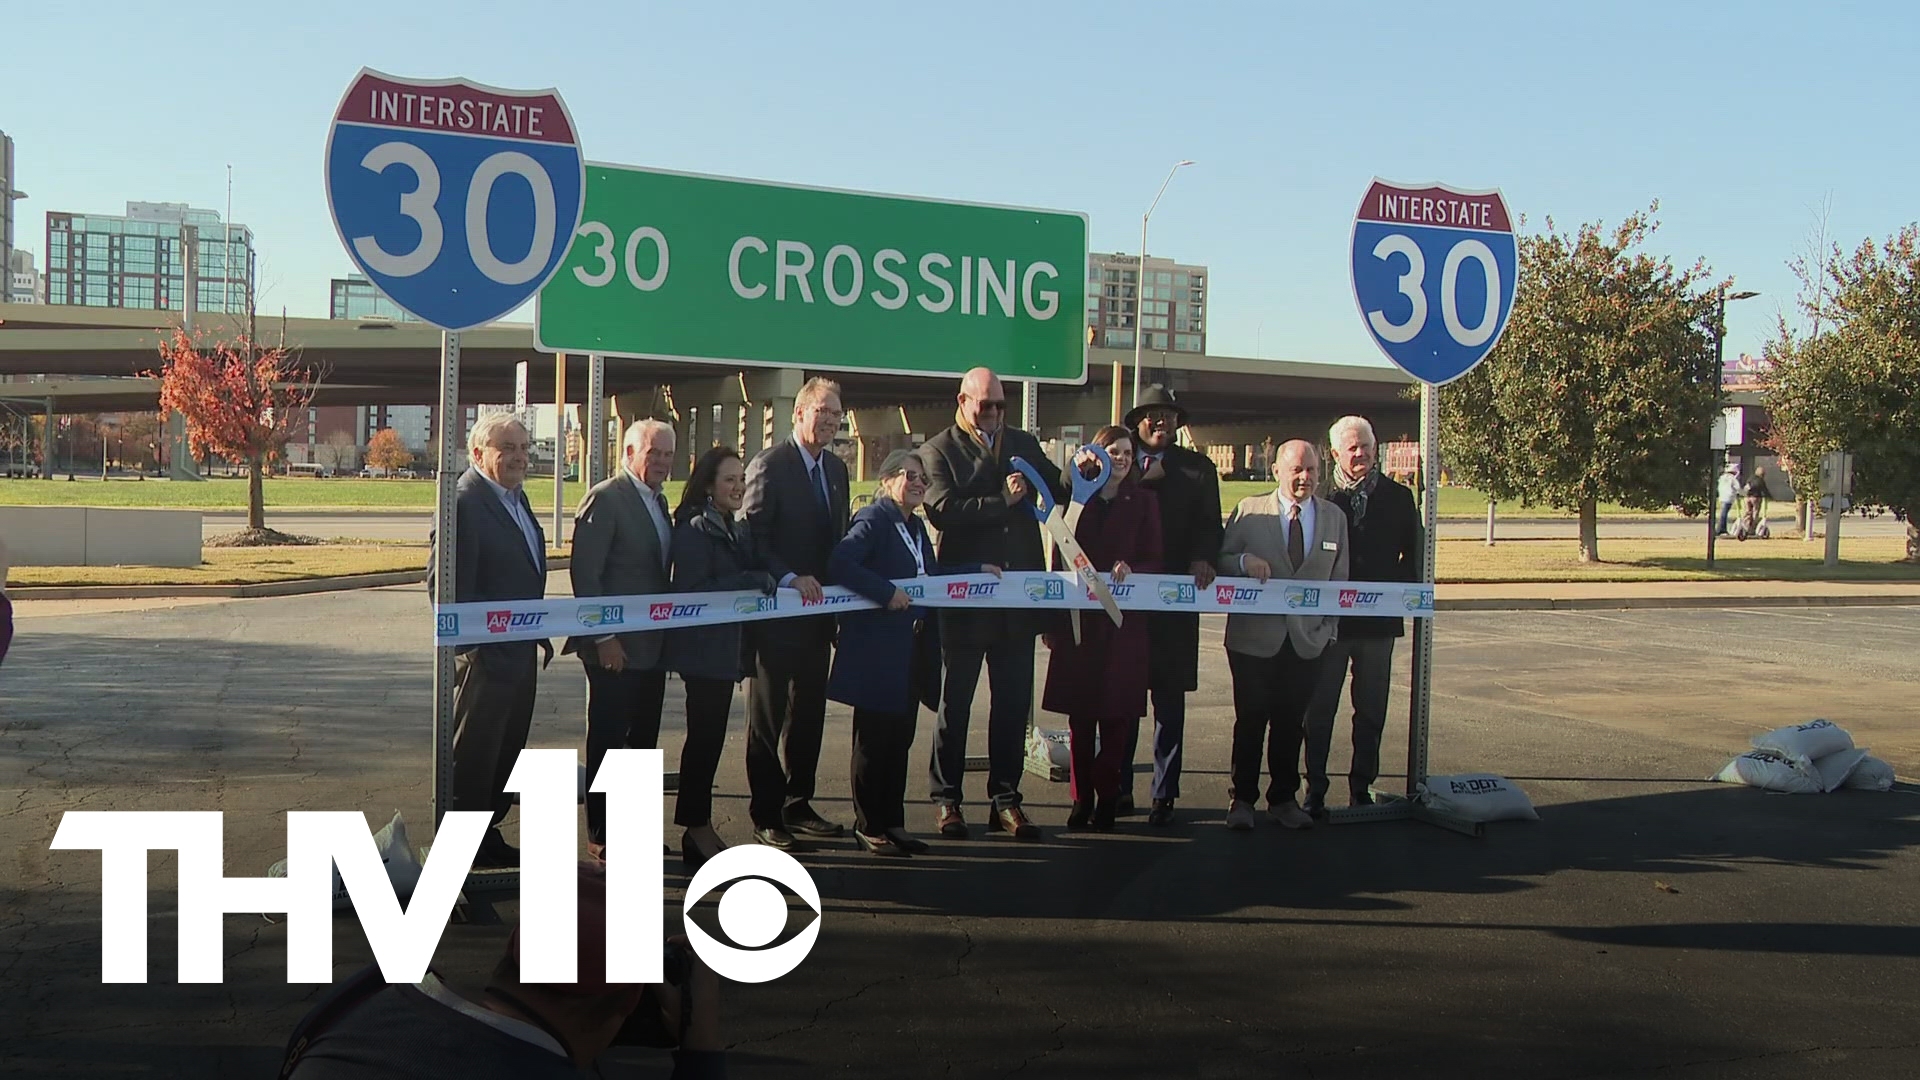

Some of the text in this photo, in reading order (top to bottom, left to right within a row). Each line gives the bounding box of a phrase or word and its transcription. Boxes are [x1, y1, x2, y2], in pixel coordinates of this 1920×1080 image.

[370, 90, 544, 137] INTERSTATE
[352, 141, 557, 285] 30
[1378, 193, 1492, 227] INTERSTATE
[572, 220, 1060, 321] 30 CROSSING
[1368, 233, 1501, 347] 30
[439, 614, 455, 631] 30
[604, 606, 620, 620] 30
[759, 597, 775, 612] 30
[1047, 581, 1061, 594] 30
[1180, 584, 1193, 598] 30
[1305, 589, 1317, 602] 30
[1422, 591, 1433, 605] 30
